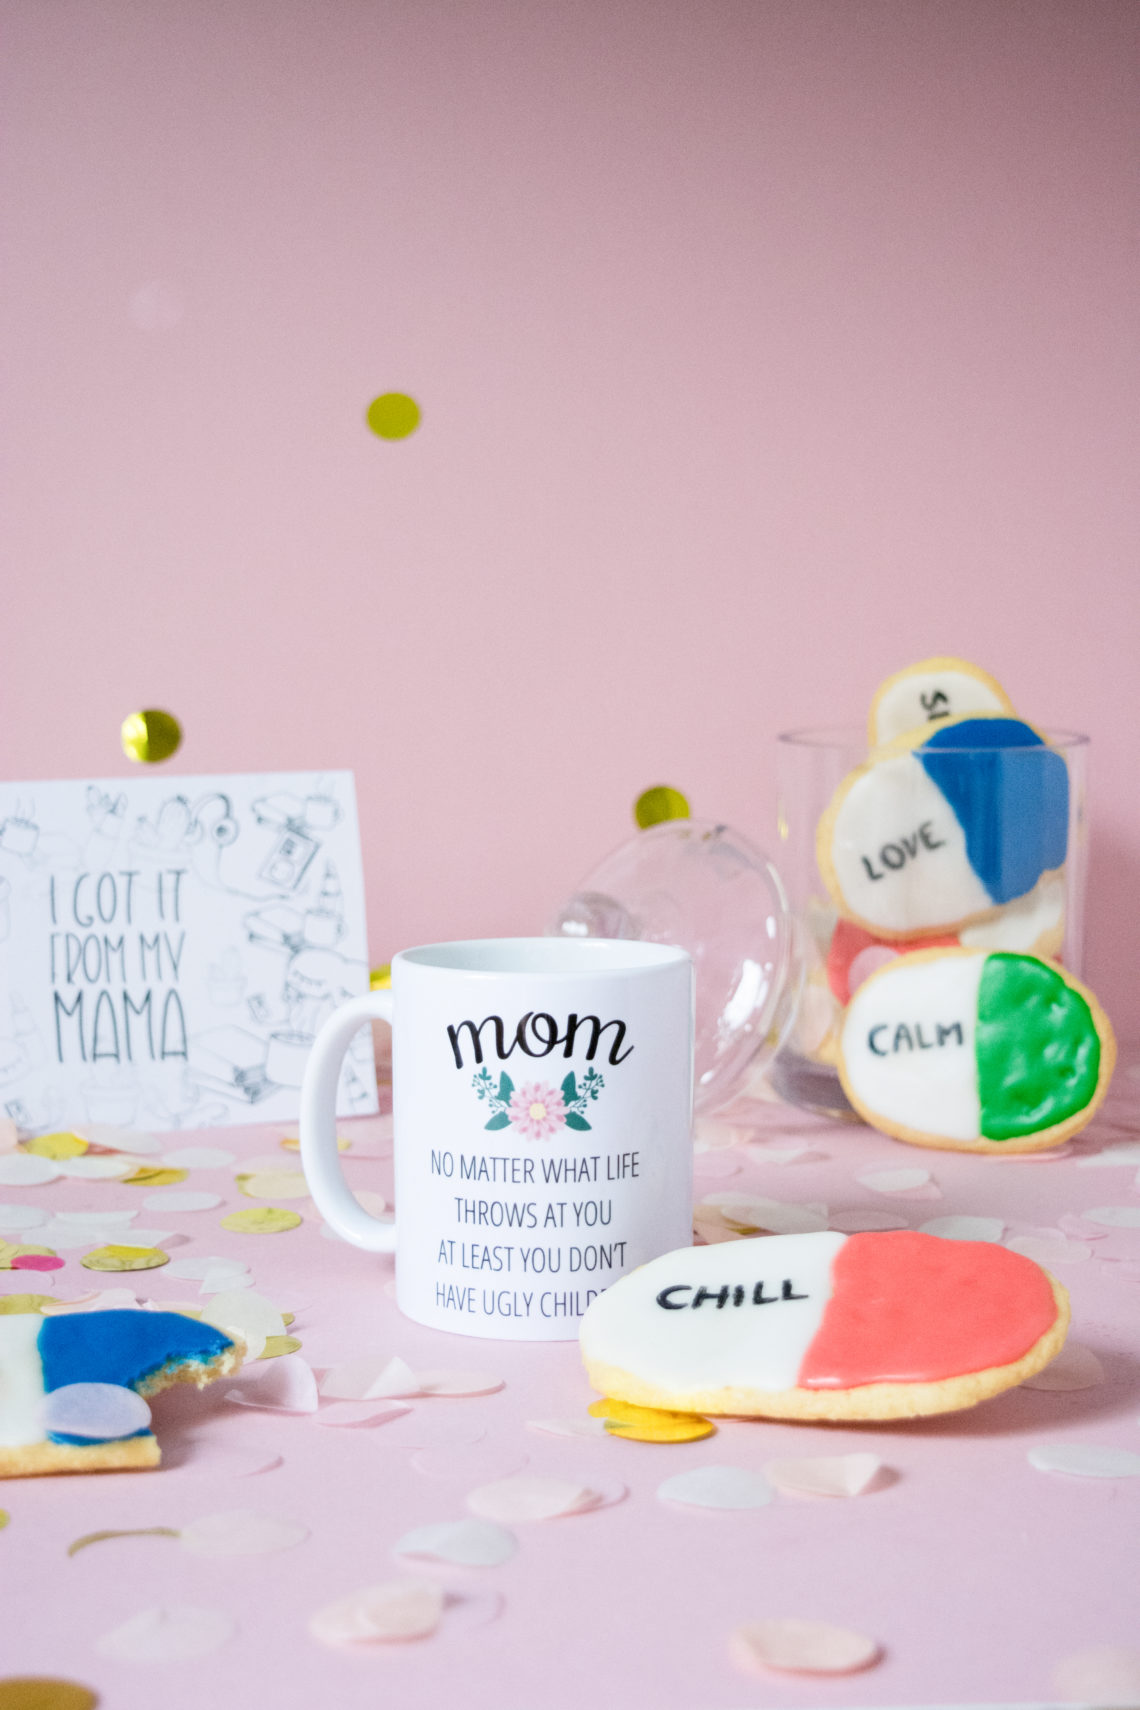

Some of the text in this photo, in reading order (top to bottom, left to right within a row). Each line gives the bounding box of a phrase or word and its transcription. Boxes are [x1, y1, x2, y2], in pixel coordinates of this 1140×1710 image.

[859, 820, 946, 882] LOVE
[49, 868, 188, 928] I GOT IT
[139, 930, 187, 983] MY
[53, 987, 189, 1064] MAMA
[446, 1011, 634, 1070] mom
[868, 1021, 964, 1058] CALM
[430, 1149, 640, 1184] NO MATTER WHAT LIFE
[454, 1197, 613, 1228] THROWS AT YOU
[437, 1239, 628, 1274] AT LEAST YOU DON'T
[435, 1281, 608, 1318] HAVE UGLY CHILD
[655, 1279, 809, 1311] CHILL
